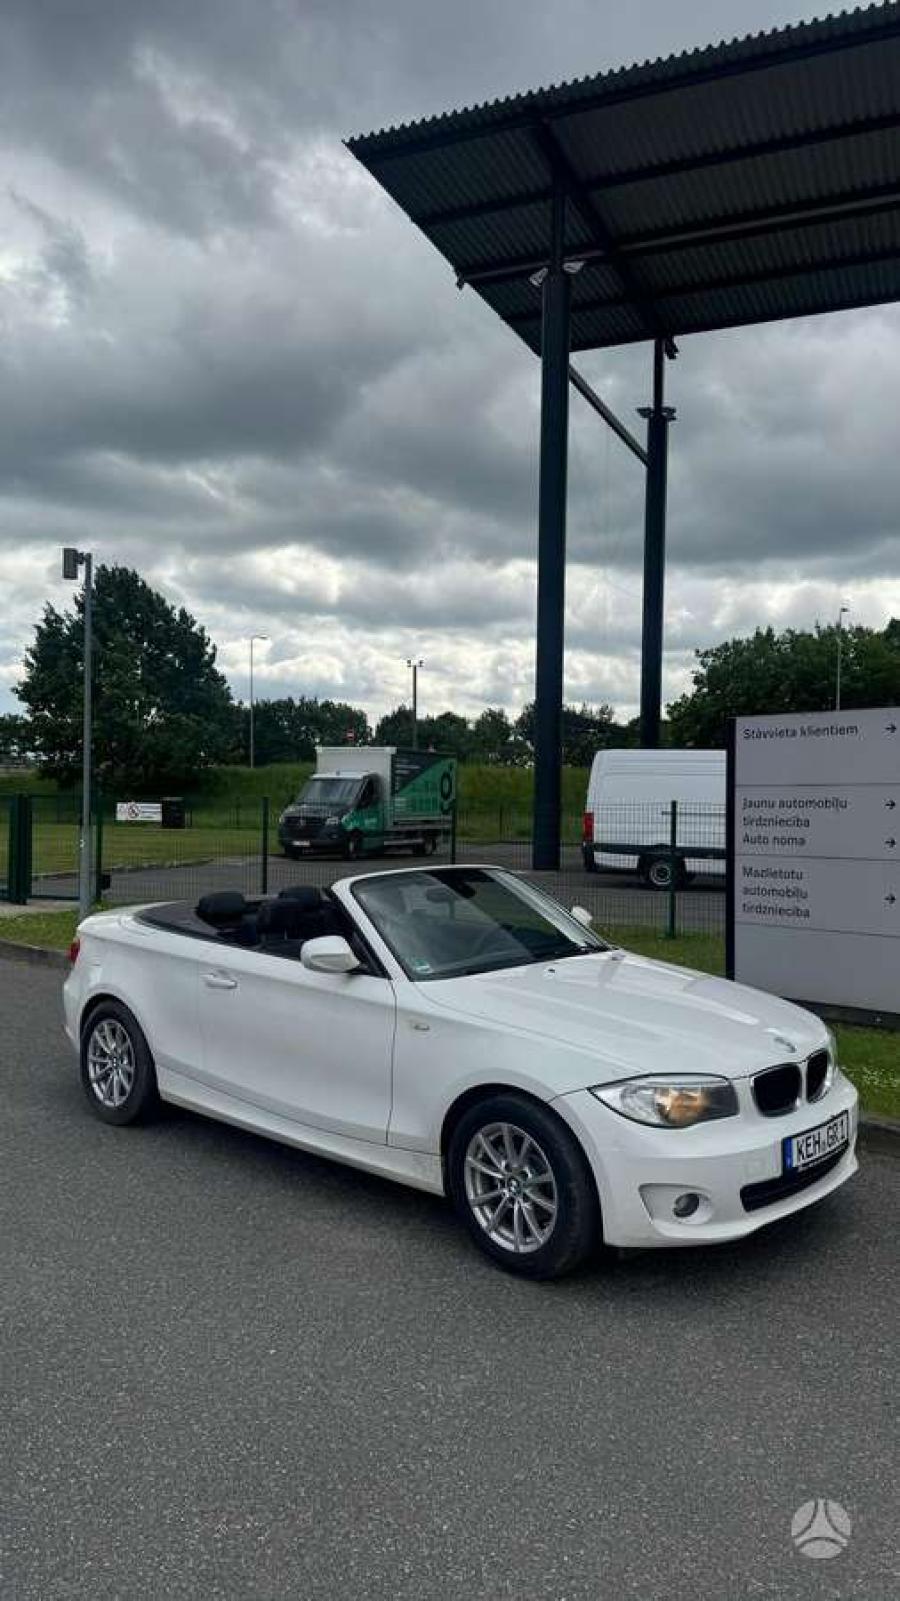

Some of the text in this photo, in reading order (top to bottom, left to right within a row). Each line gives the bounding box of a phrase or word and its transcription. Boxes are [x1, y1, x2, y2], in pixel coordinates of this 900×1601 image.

[800, 724, 859, 738] klientiem
[742, 798, 775, 810] Jaunu
[742, 832, 806, 847] Auto noma
[797, 1131, 821, 1161] KEH
